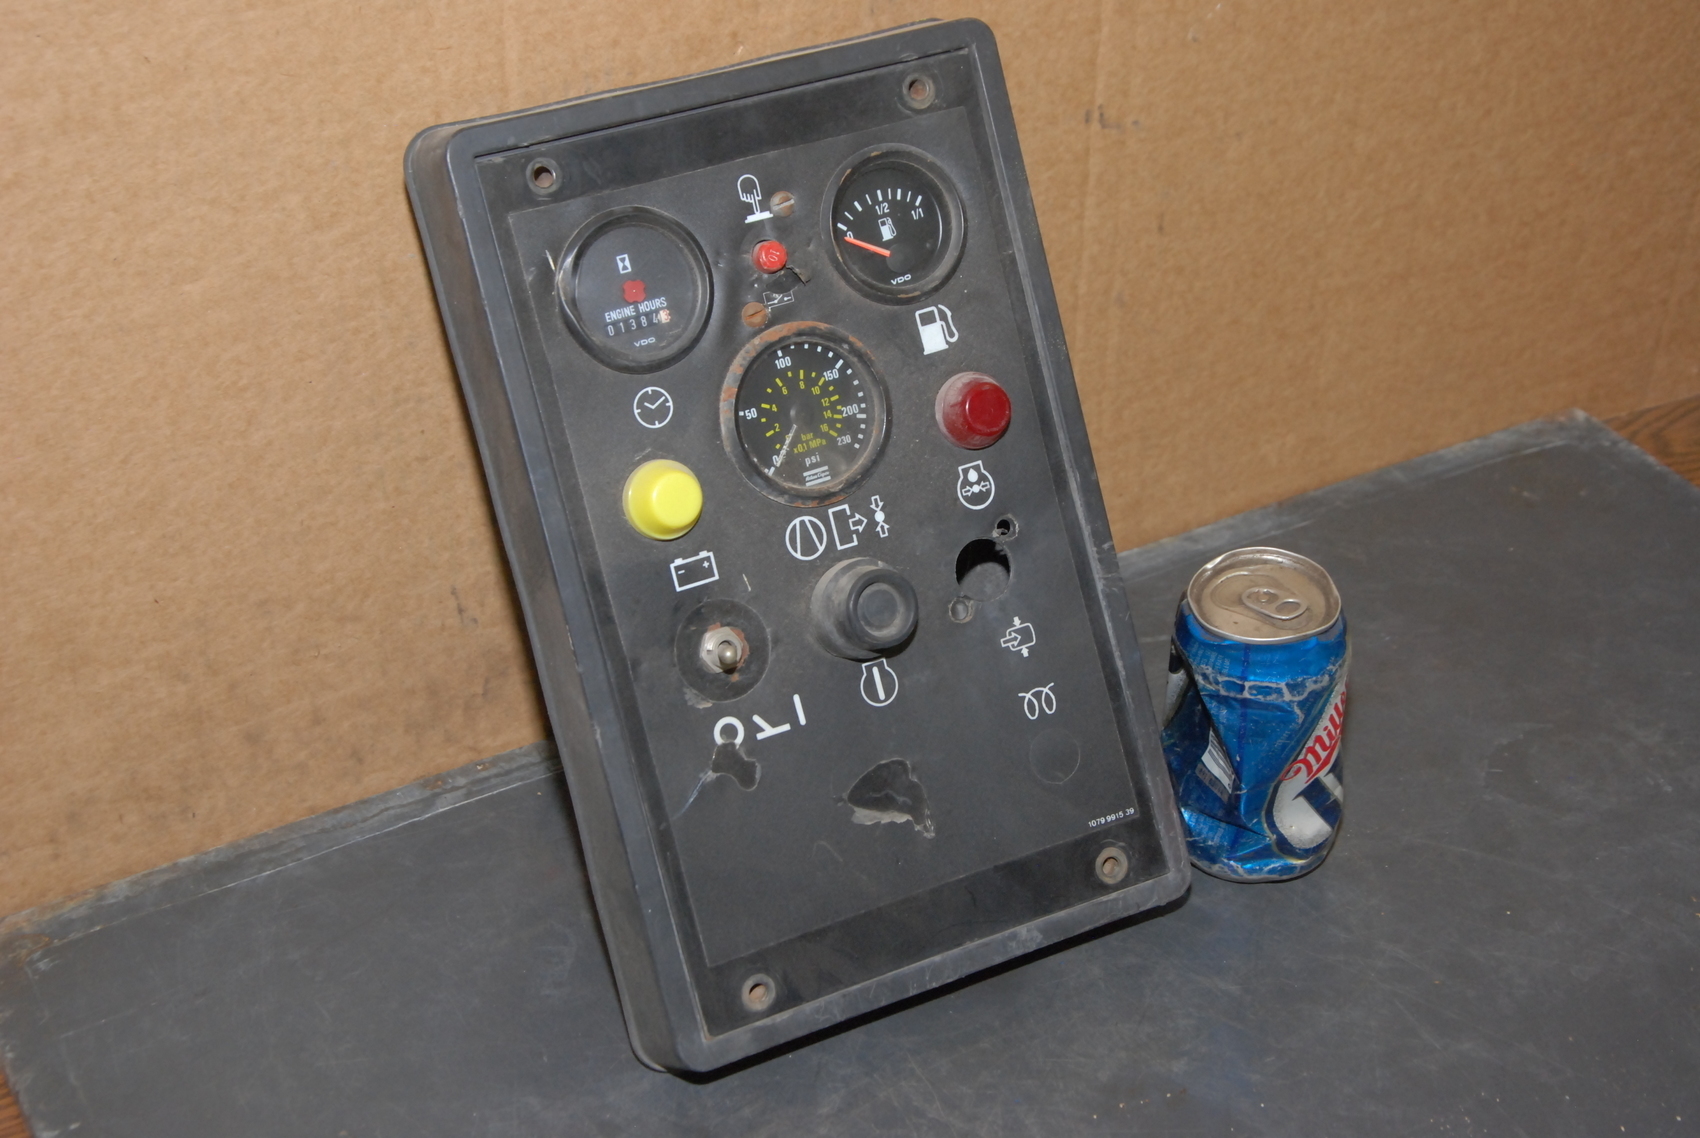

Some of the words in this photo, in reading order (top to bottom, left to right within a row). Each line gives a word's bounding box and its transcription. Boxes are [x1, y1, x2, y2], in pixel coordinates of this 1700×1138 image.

[875, 202, 890, 215] 1/2
[911, 208, 924, 220] 1/1
[890, 274, 912, 285] VDO
[604, 305, 636, 322] ENGINE
[638, 297, 668, 313] HOURS
[633, 337, 656, 347] VDO
[775, 356, 791, 369] 100
[823, 368, 839, 381] 150
[799, 380, 805, 389] 8
[811, 385, 820, 395] 10
[782, 386, 788, 395] 6
[771, 403, 777, 412] 4
[821, 397, 830, 407] 12
[745, 407, 758, 420] 50
[823, 409, 832, 419] 14
[841, 403, 859, 417] 200
[774, 423, 780, 432] 2
[820, 423, 829, 432] 16
[801, 432, 814, 441] bar
[836, 434, 852, 446] 230
[808, 438, 827, 449] MPa
[805, 452, 820, 467] psi
[1280, 685, 1347, 782] Mille
[1088, 817, 1105, 827] 1079
[1105, 810, 1124, 822] 9915
[1125, 807, 1135, 816] 39
